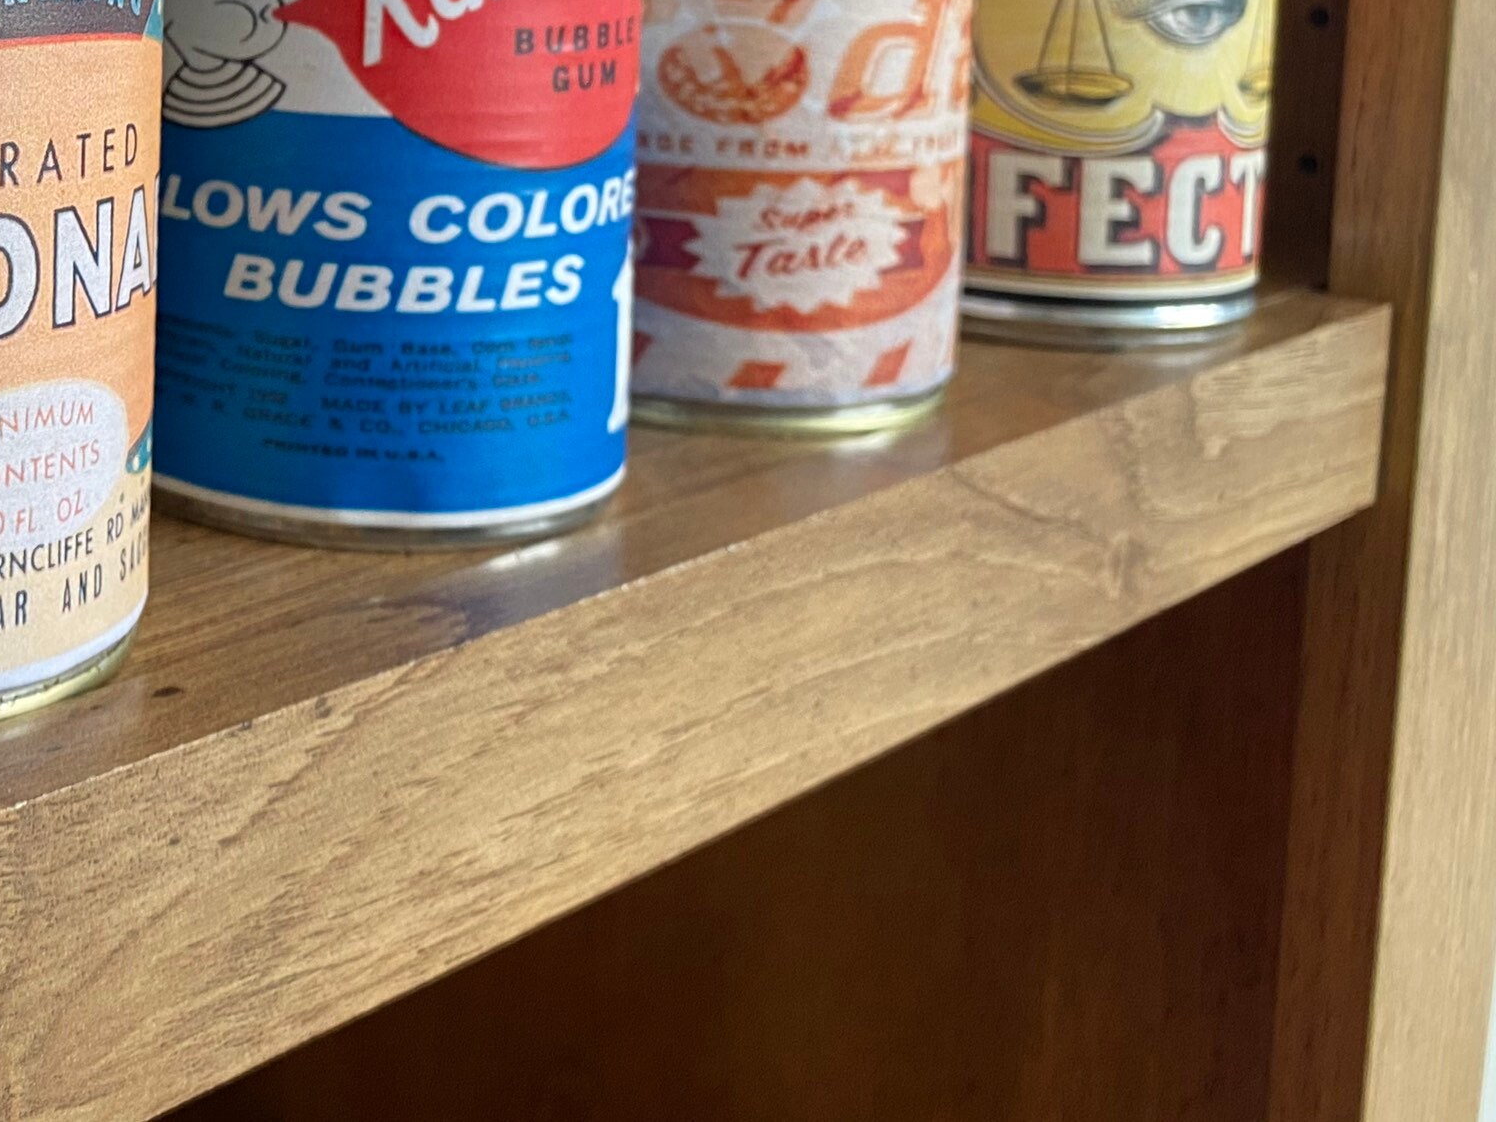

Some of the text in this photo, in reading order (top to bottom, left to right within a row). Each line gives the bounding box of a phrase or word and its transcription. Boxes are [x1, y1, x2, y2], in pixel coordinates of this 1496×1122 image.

[514, 15, 636, 57] BUBBLE
[552, 61, 618, 92] GUM
[160, 174, 372, 242] LOWS
[733, 234, 867, 280] Taste
[223, 253, 585, 313] BUBBLES
[106, 512, 123, 545] RD
[61, 568, 103, 616] AND
